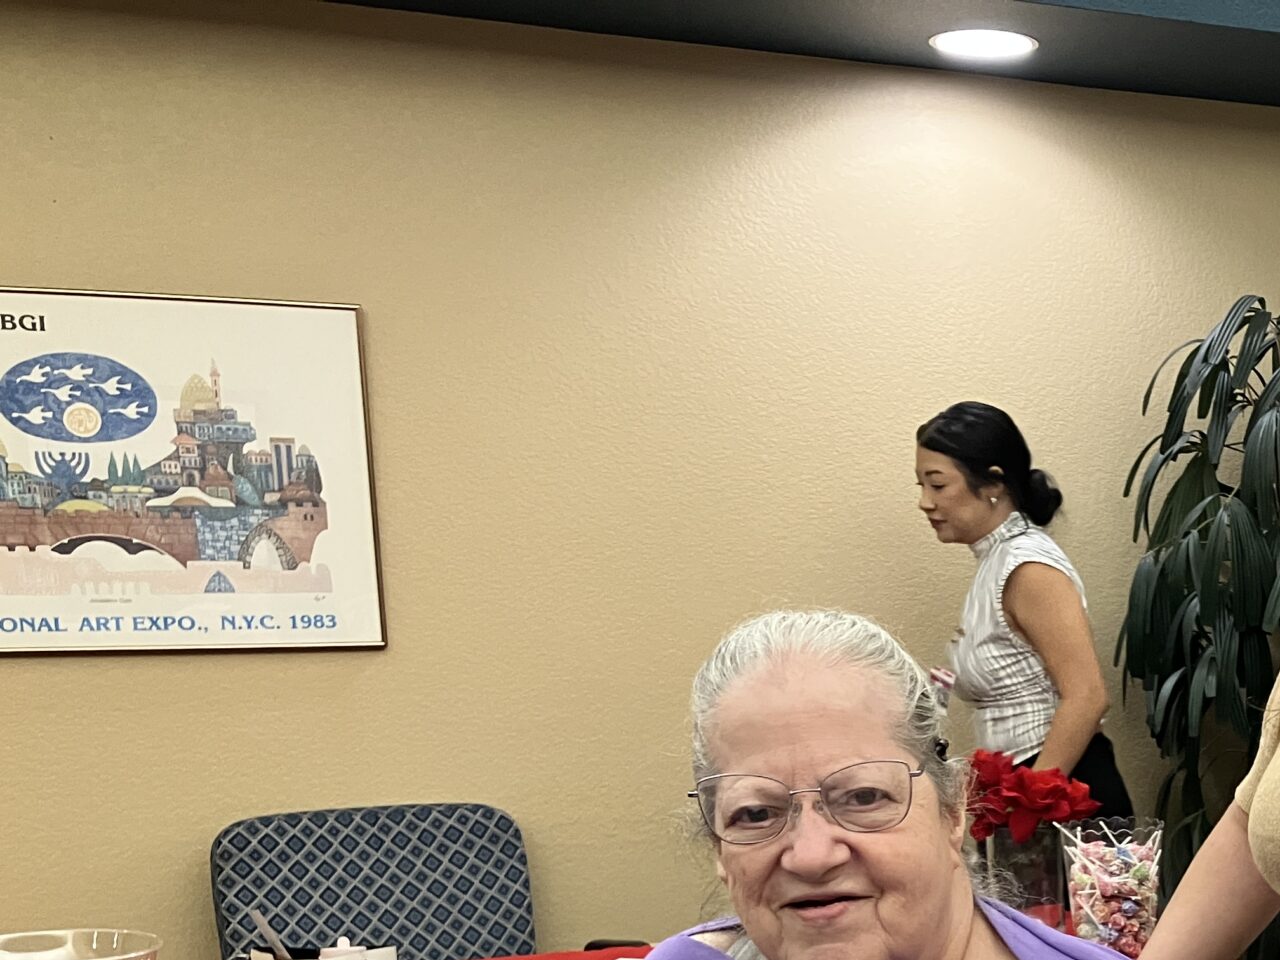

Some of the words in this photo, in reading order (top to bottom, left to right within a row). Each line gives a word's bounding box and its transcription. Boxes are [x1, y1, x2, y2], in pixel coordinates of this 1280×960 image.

[0, 617, 68, 633] ONAL
[78, 616, 124, 632] ART
[221, 615, 281, 631] N.Y.C.
[289, 614, 338, 630] 1983
